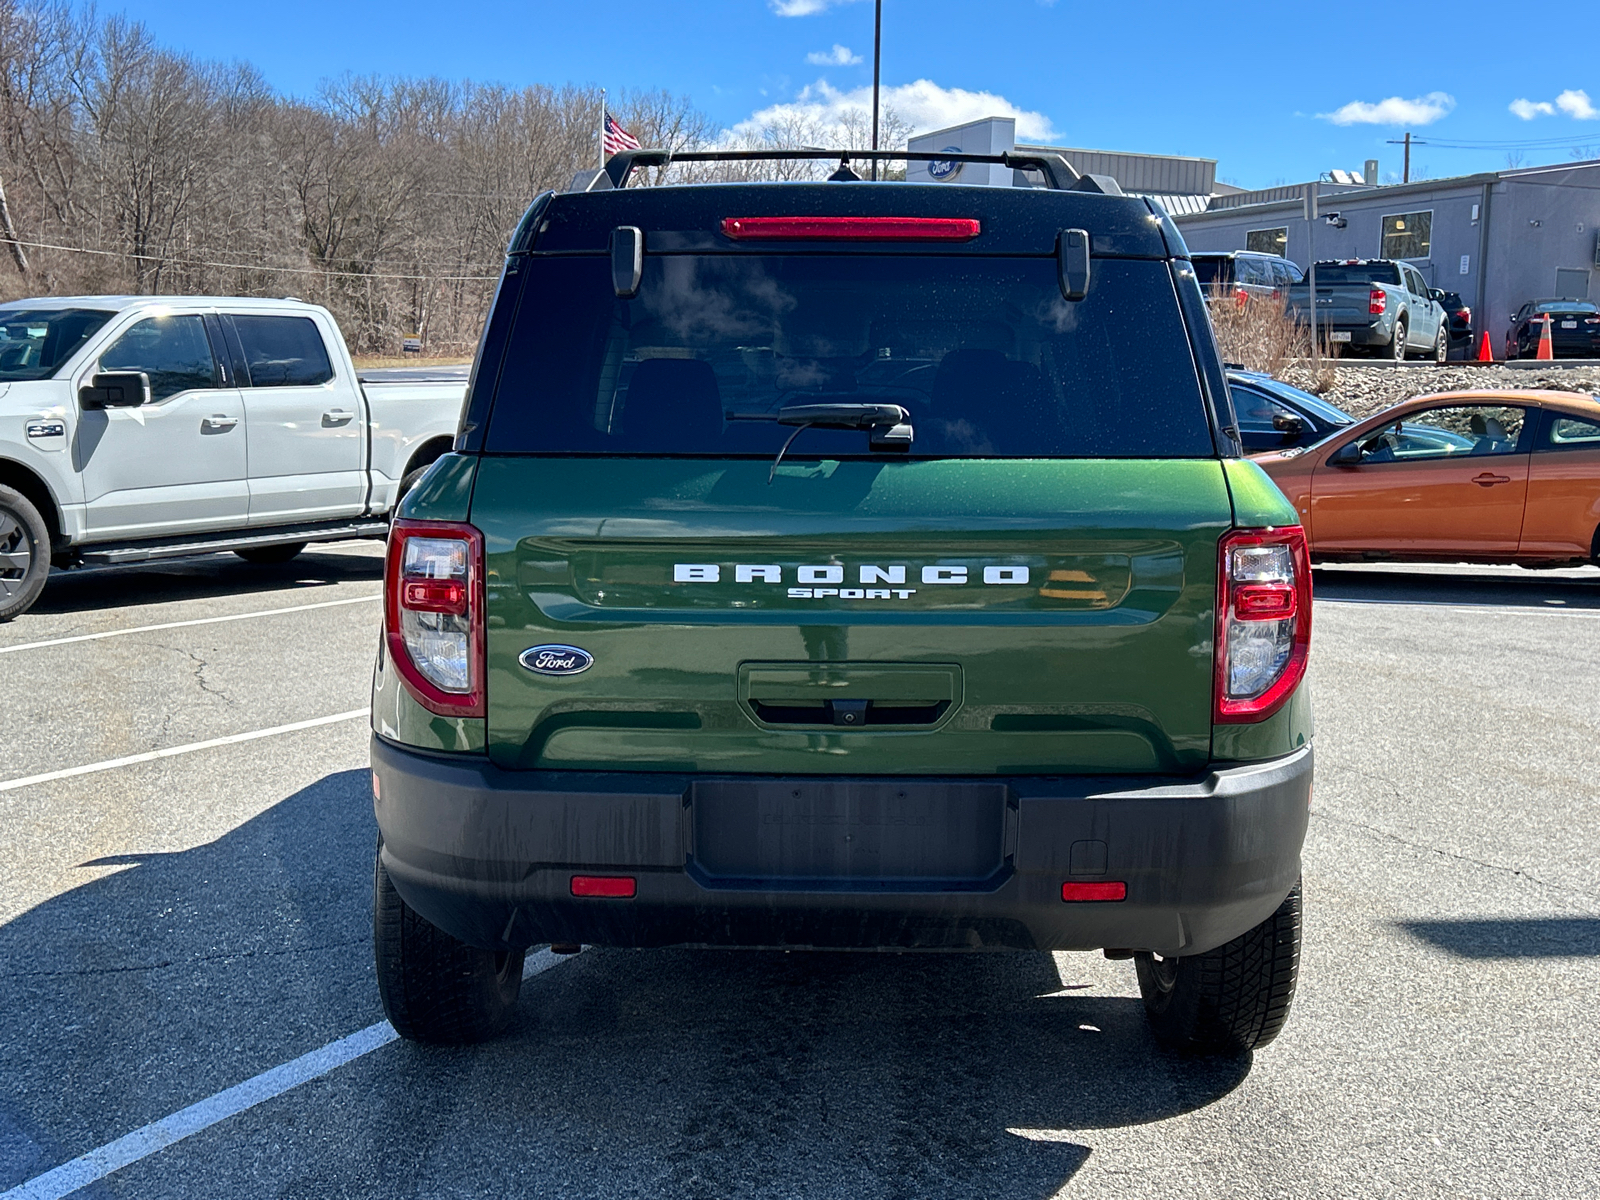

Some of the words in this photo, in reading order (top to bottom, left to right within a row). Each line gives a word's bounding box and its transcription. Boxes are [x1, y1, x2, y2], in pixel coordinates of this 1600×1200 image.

[673, 563, 1030, 585] BRONCO
[787, 588, 917, 600] SPORT
[535, 650, 576, 669] Ford
